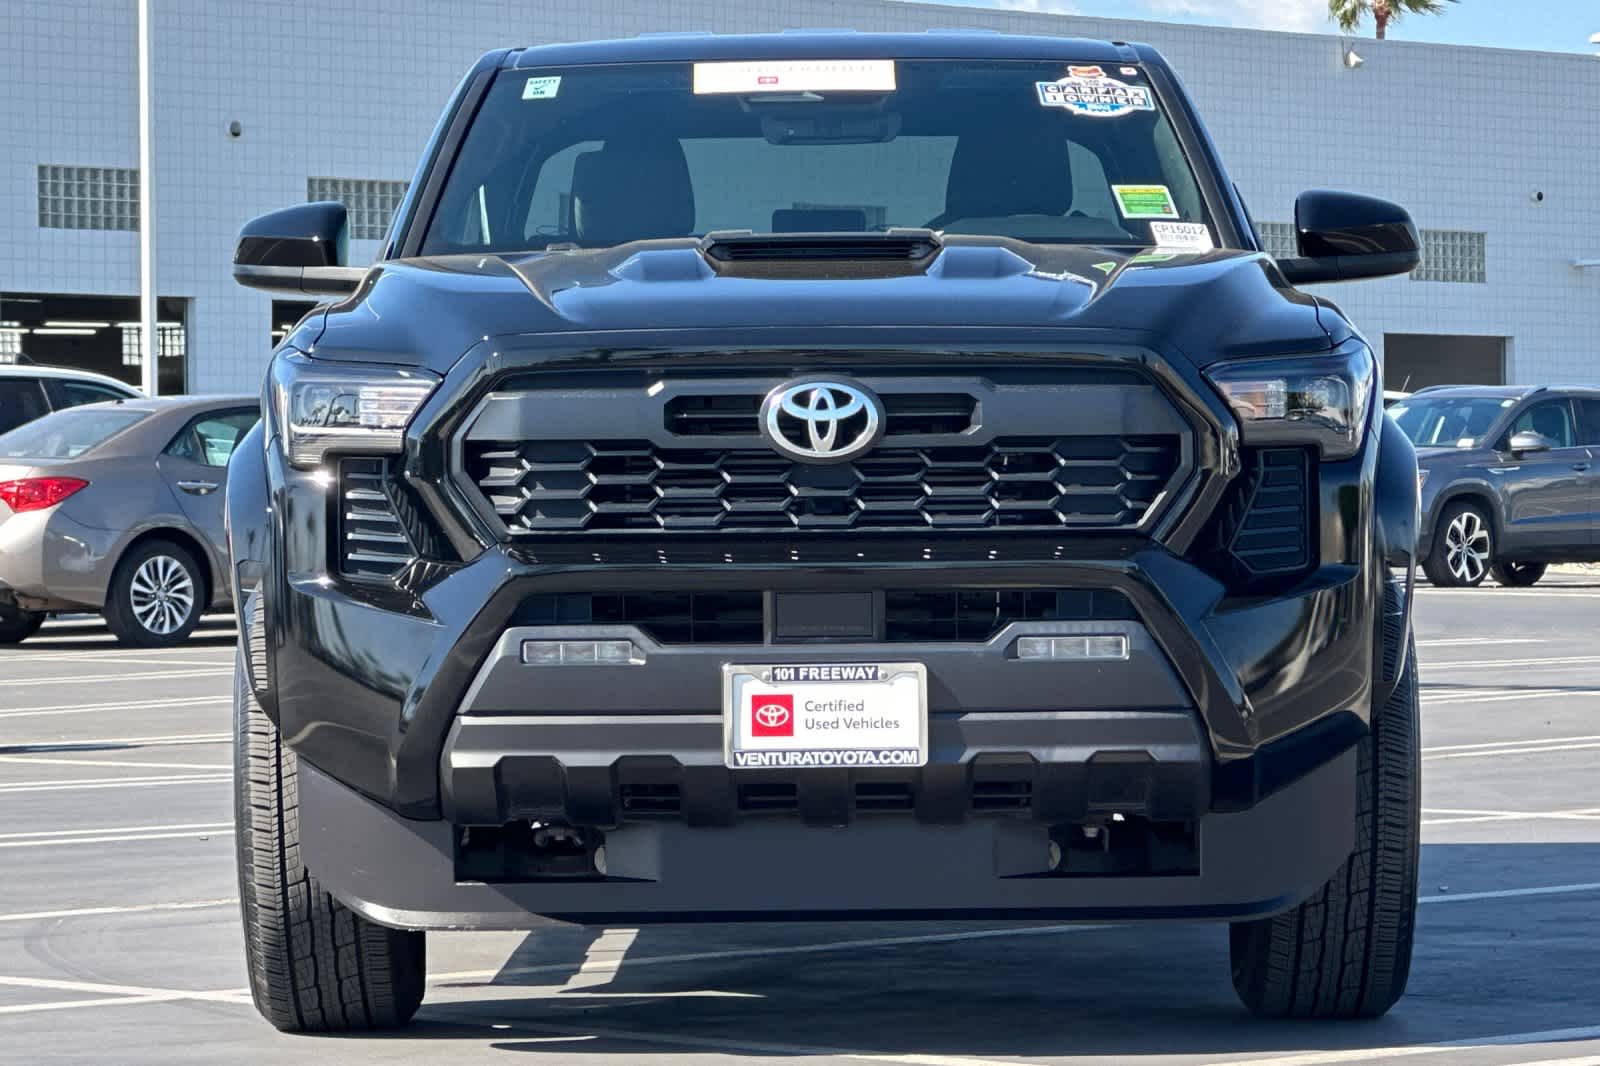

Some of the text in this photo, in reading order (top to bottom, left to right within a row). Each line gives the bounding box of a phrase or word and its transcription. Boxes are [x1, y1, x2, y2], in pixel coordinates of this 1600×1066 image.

[1045, 84, 1144, 98] CARFAX
[1063, 94, 1144, 106] OWNER
[774, 666, 876, 681] 101 FREEWAY
[804, 699, 865, 713] Certified
[805, 716, 900, 730] Used Vehicles
[735, 750, 918, 766] VENTURATOYOTA.COM
